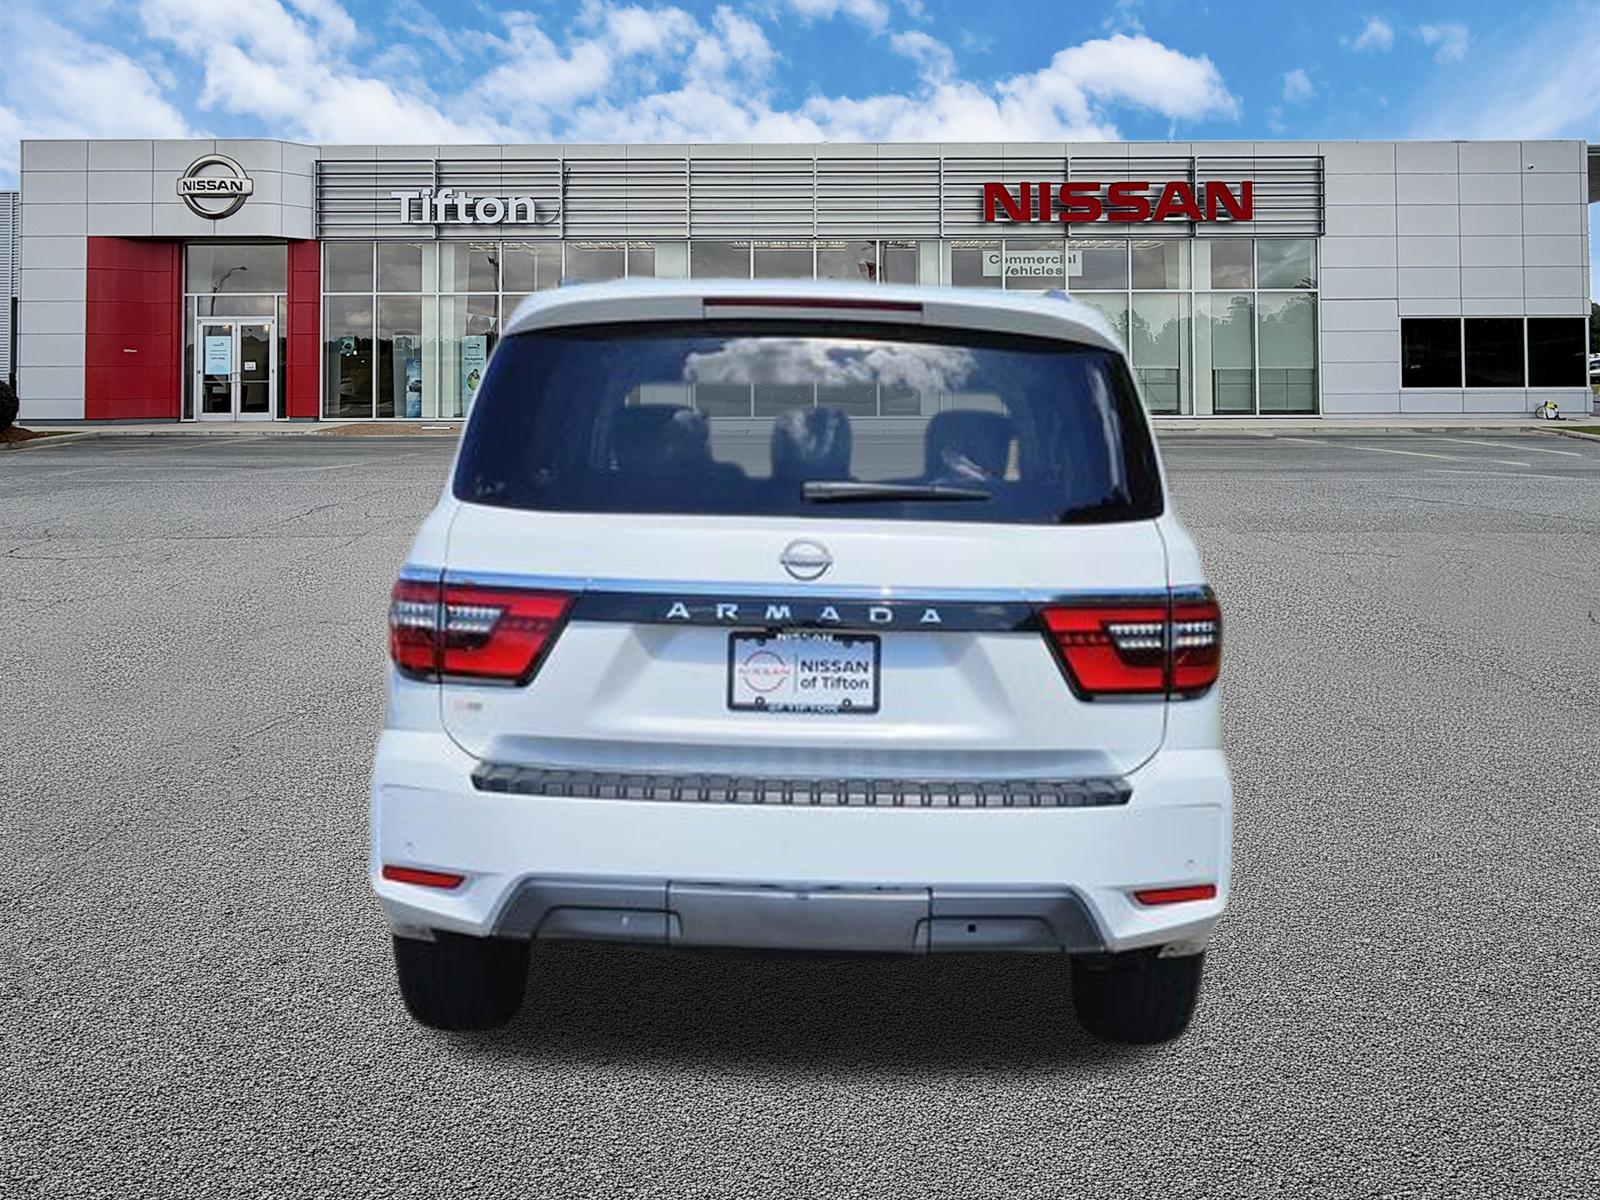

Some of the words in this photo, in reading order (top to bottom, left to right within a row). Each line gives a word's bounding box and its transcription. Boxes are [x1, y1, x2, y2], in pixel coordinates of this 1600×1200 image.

[182, 180, 243, 191] NISSAN
[391, 188, 536, 224] Tifton
[983, 181, 1253, 222] NISSAN
[666, 602, 942, 624] ARMADA
[800, 660, 869, 673] NISSAN
[800, 676, 816, 690] of
[820, 676, 869, 690] Tifton
